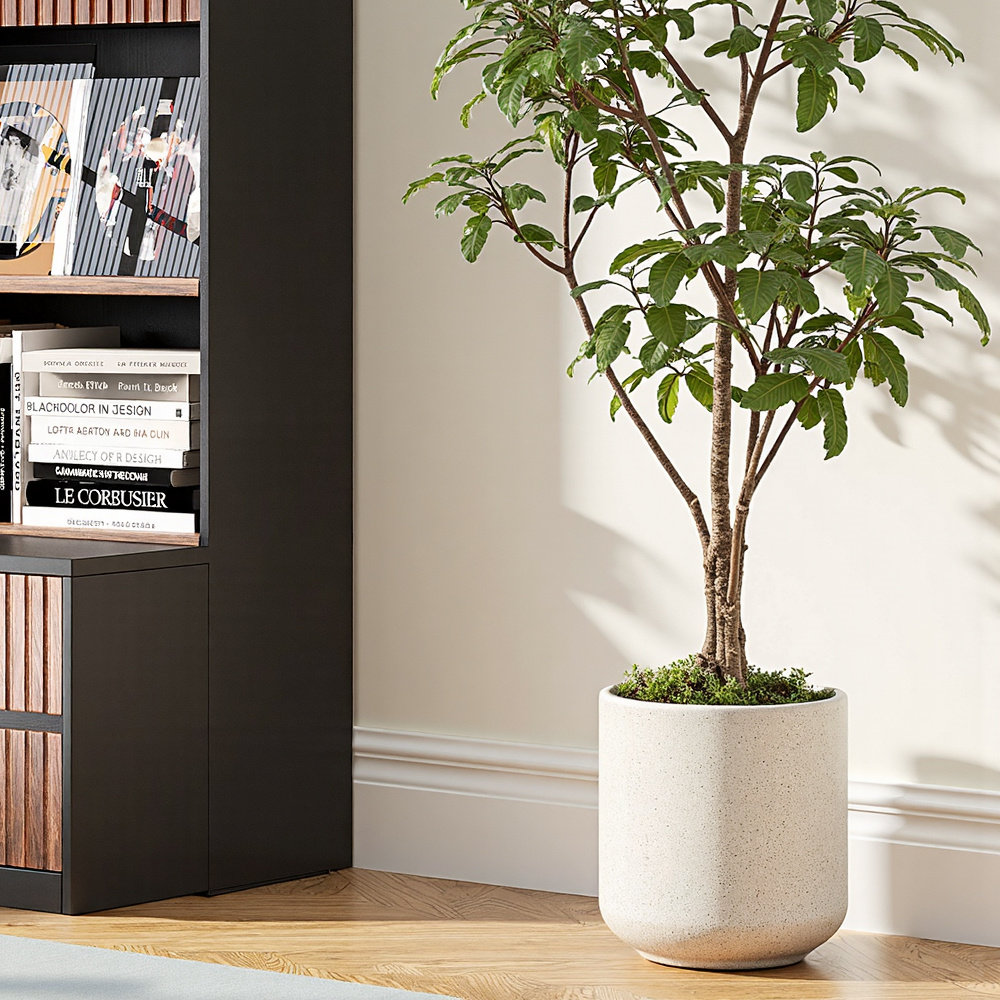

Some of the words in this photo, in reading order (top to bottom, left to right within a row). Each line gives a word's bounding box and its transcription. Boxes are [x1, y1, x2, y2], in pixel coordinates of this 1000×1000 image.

[98, 403, 109, 414] IN
[54, 487, 75, 504] LE
[77, 488, 169, 509] CORBUSIER
